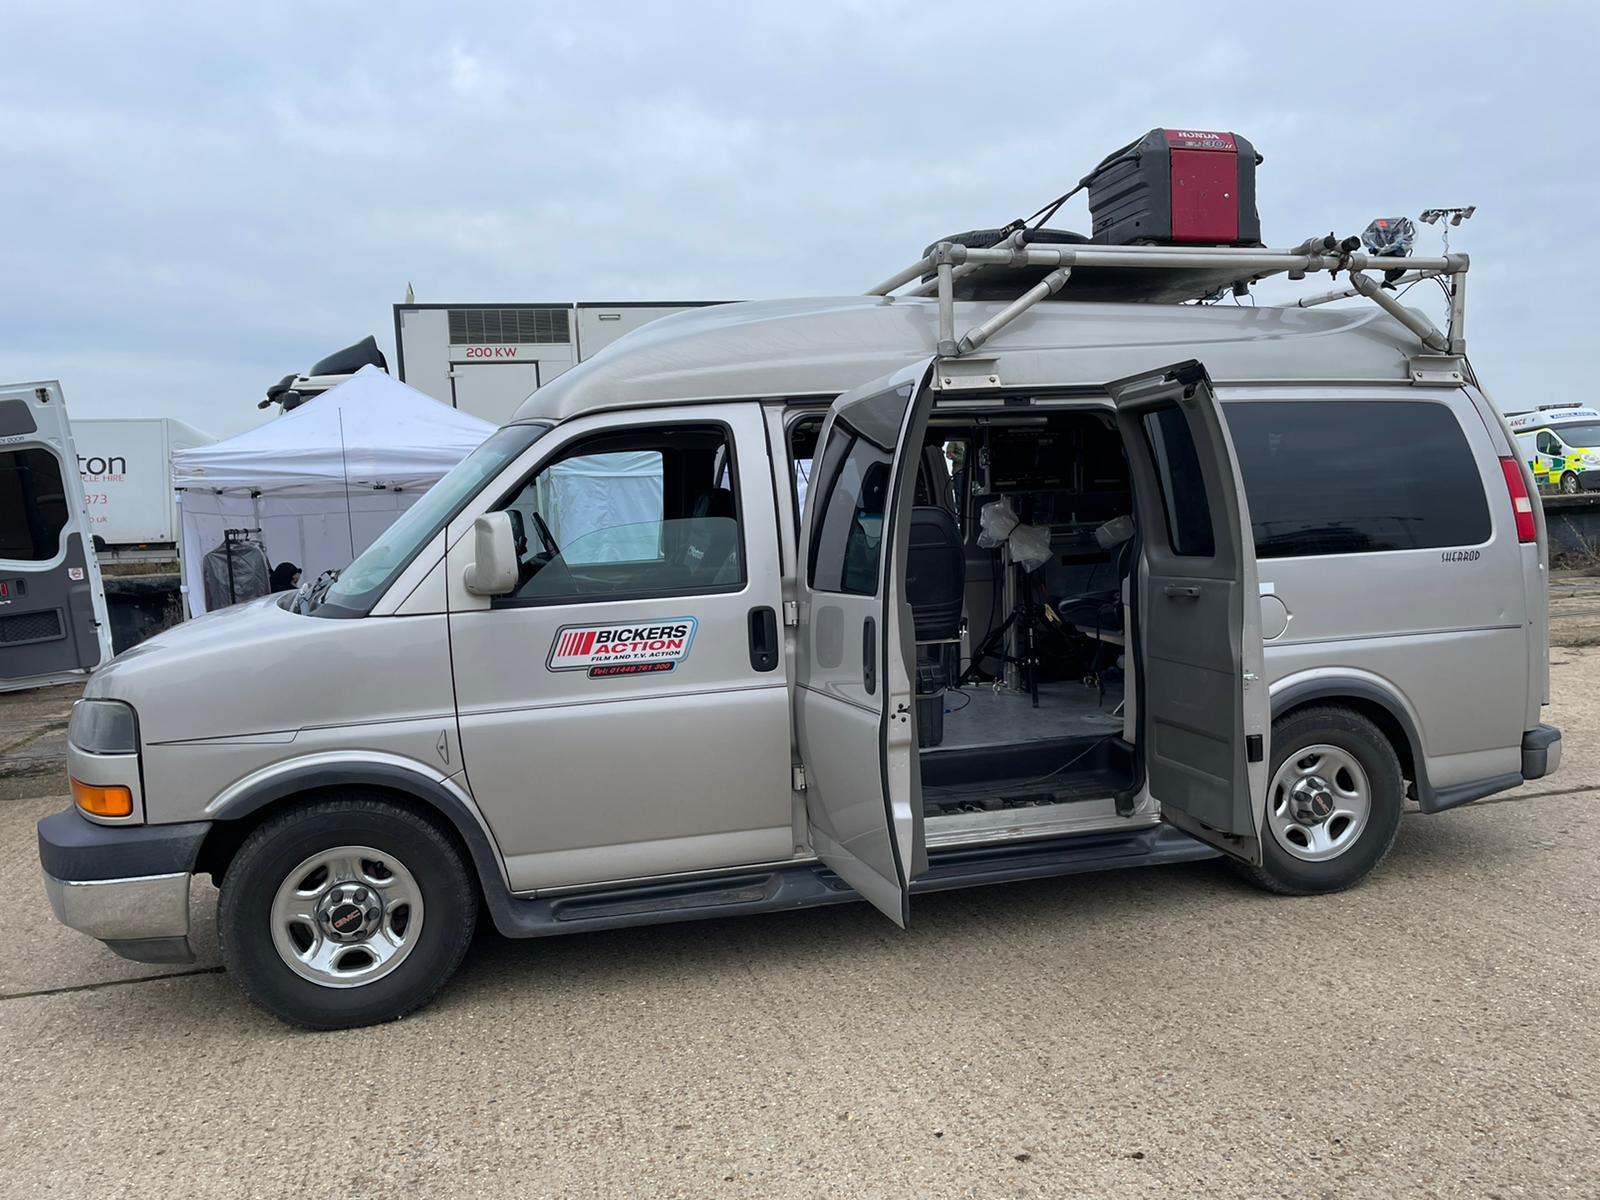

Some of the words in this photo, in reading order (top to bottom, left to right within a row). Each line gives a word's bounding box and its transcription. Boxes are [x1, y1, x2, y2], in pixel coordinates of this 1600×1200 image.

[1177, 131, 1220, 139] HONDA
[466, 347, 493, 358] 200
[495, 347, 517, 358] KW
[76, 454, 126, 475] ton
[1441, 551, 1481, 563] SHERROD
[596, 625, 687, 643] BICKERS
[594, 639, 683, 654] ACTION
[613, 653, 632, 661] AND
[334, 909, 361, 928] GMC
